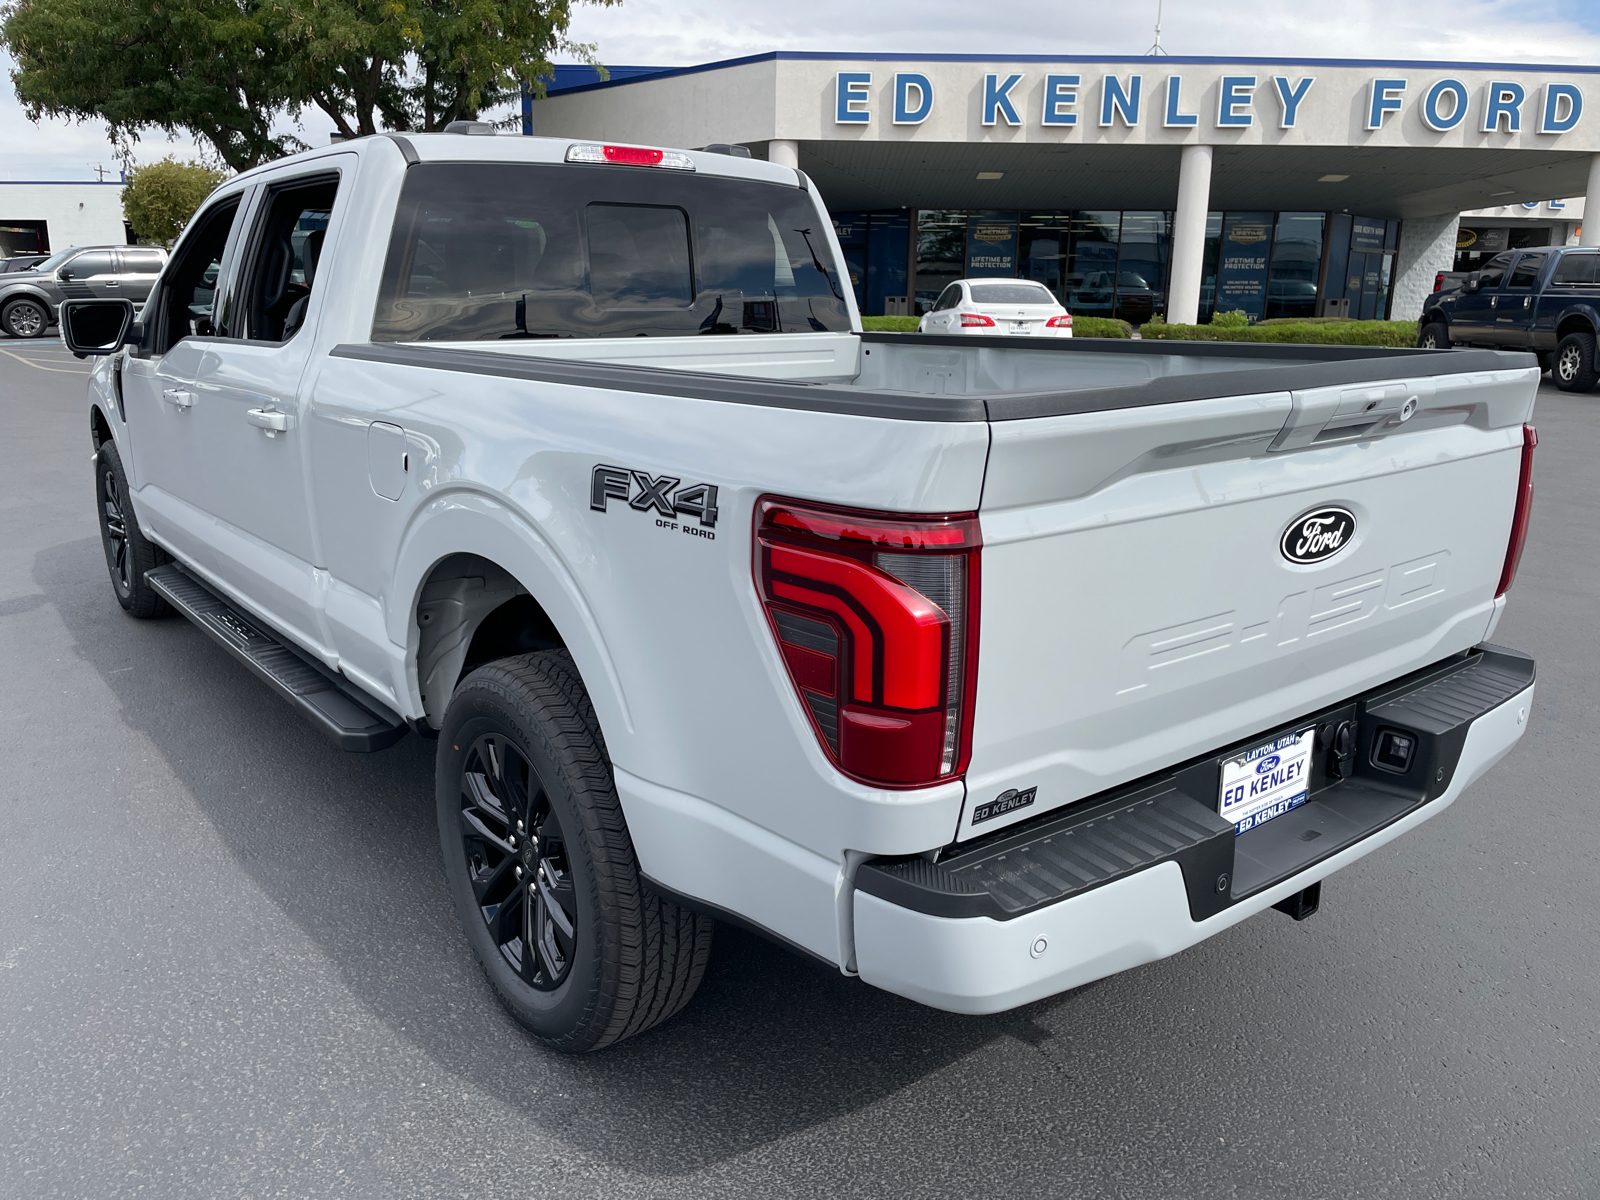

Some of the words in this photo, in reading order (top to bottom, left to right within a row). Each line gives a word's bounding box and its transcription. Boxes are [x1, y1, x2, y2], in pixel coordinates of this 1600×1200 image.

[835, 72, 935, 125] ED
[981, 73, 1316, 128] KENLEY
[1365, 78, 1584, 134] FORD
[590, 463, 719, 529] FX4
[655, 519, 679, 530] OFF
[683, 525, 715, 540] ROAD
[1296, 515, 1345, 556] Ford
[1246, 743, 1276, 761] LAYTON,
[1277, 734, 1296, 749] UTAH
[1260, 757, 1277, 773] Ford
[1224, 785, 1244, 807] ED
[1250, 759, 1304, 797] KENLEY
[973, 809, 989, 821] ED
[992, 791, 1035, 815] KENLEY
[1239, 817, 1252, 832] ED
[1255, 799, 1290, 825] KENLEY
